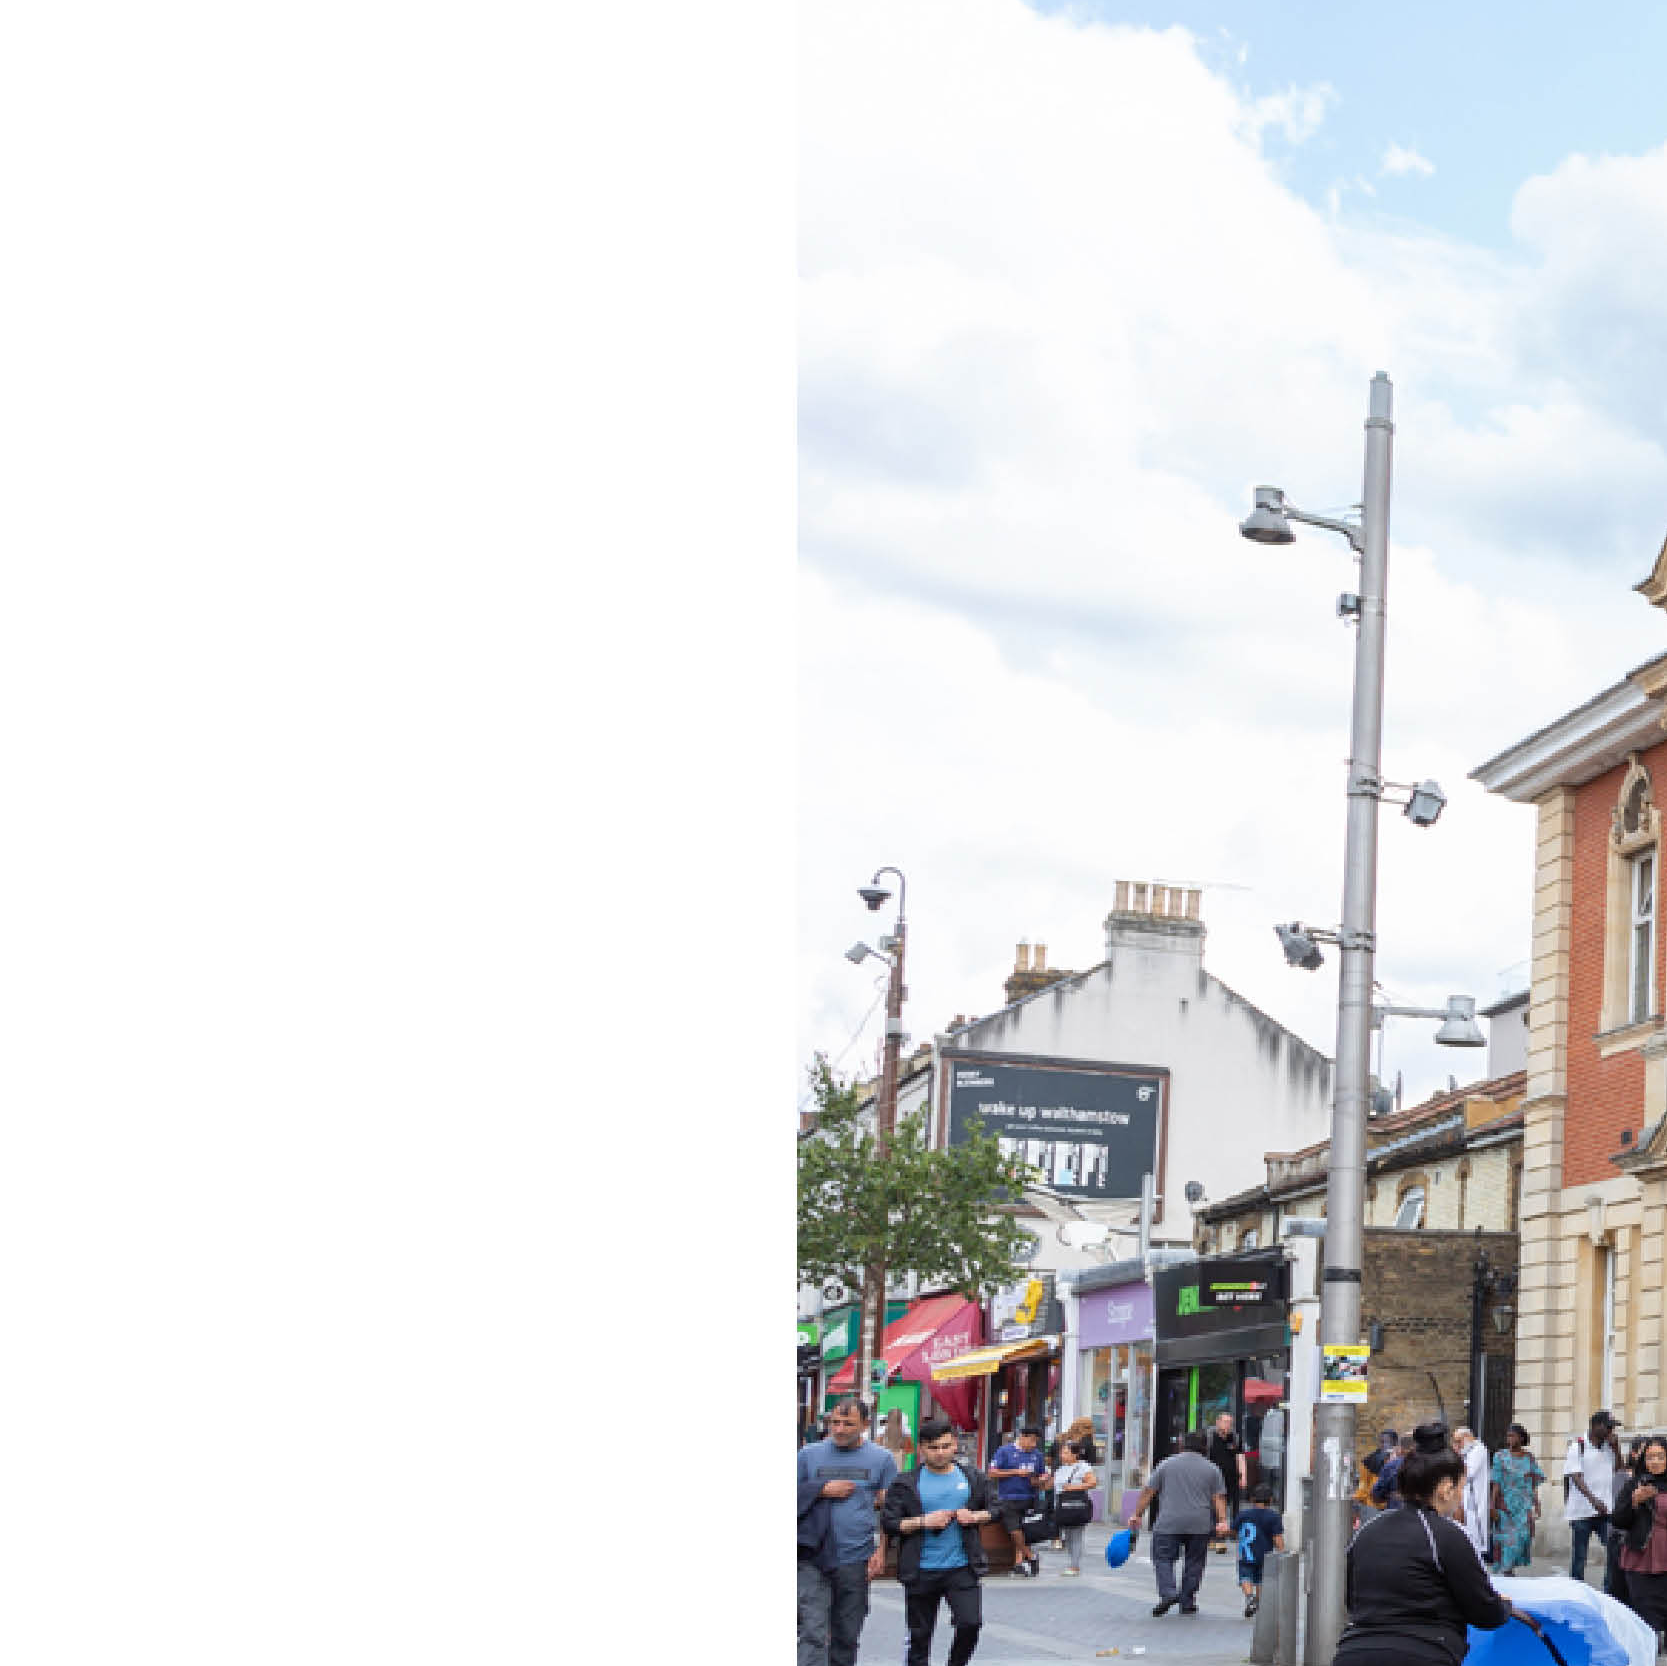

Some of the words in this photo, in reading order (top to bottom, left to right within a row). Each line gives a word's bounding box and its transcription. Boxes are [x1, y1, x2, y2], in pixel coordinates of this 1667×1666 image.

[978, 1100, 1016, 1116] wake
[1018, 1106, 1037, 1122] up
[1041, 1106, 1130, 1126] walthamstow
[1239, 1522, 1257, 1561] R
